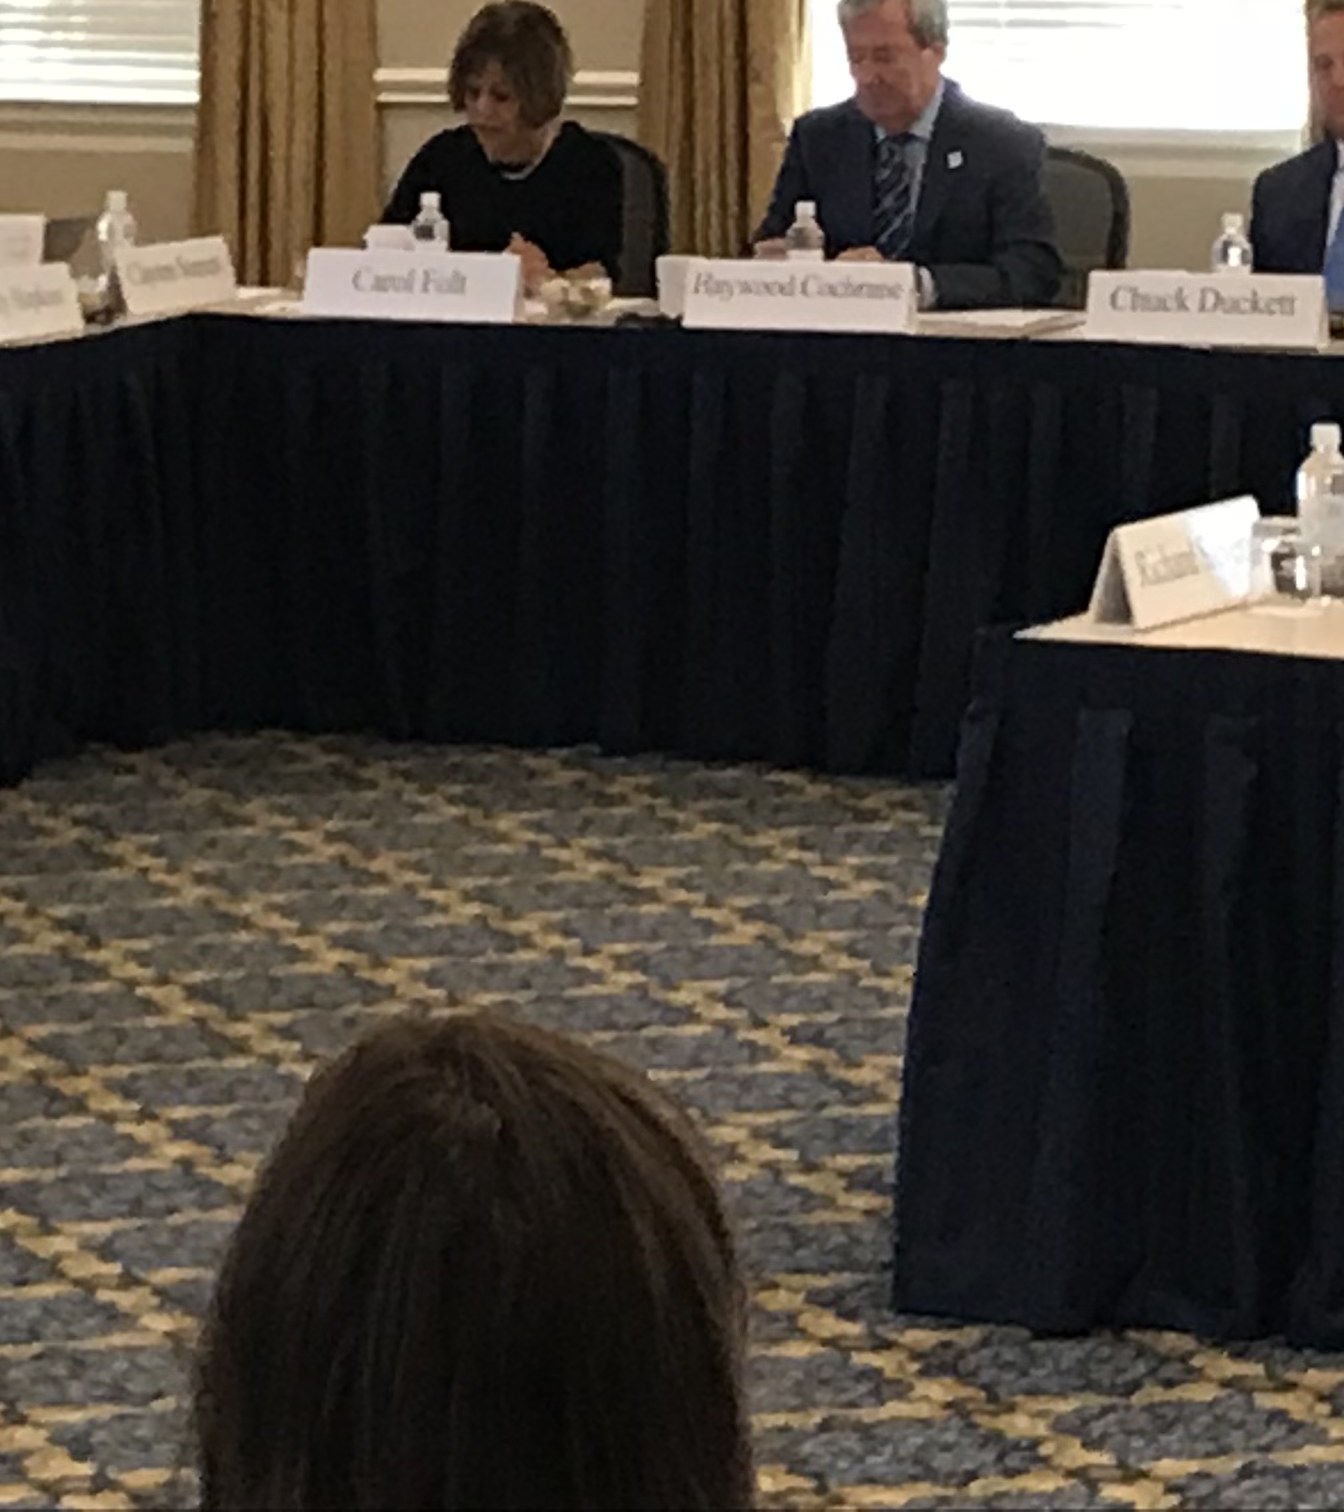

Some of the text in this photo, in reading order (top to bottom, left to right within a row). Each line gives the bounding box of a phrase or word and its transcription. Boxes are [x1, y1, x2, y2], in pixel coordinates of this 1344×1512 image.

[693, 271, 795, 301] Haywood
[1110, 285, 1298, 317] Chuck Duckett
